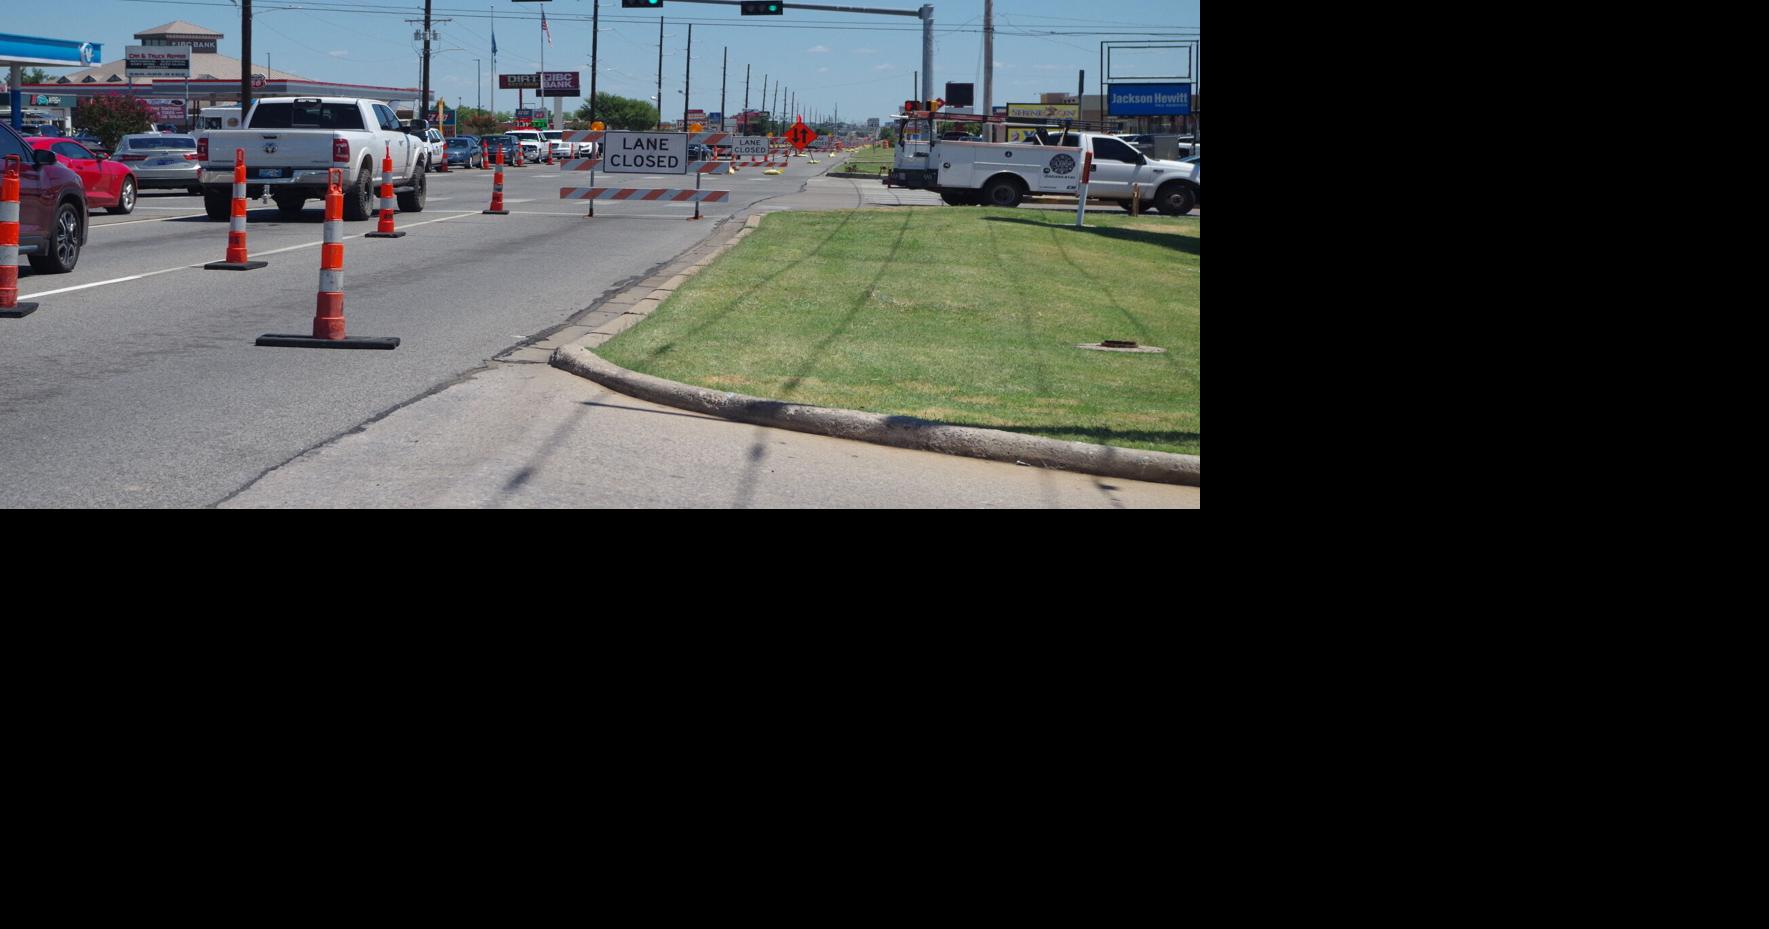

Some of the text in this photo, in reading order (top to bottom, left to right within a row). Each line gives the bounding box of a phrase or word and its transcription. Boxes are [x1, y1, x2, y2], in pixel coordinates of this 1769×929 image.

[507, 75, 539, 83] DIRT
[1112, 93, 1188, 104] Jackson Hewitt
[622, 137, 669, 151] LANE
[610, 154, 679, 168] CLOSED
